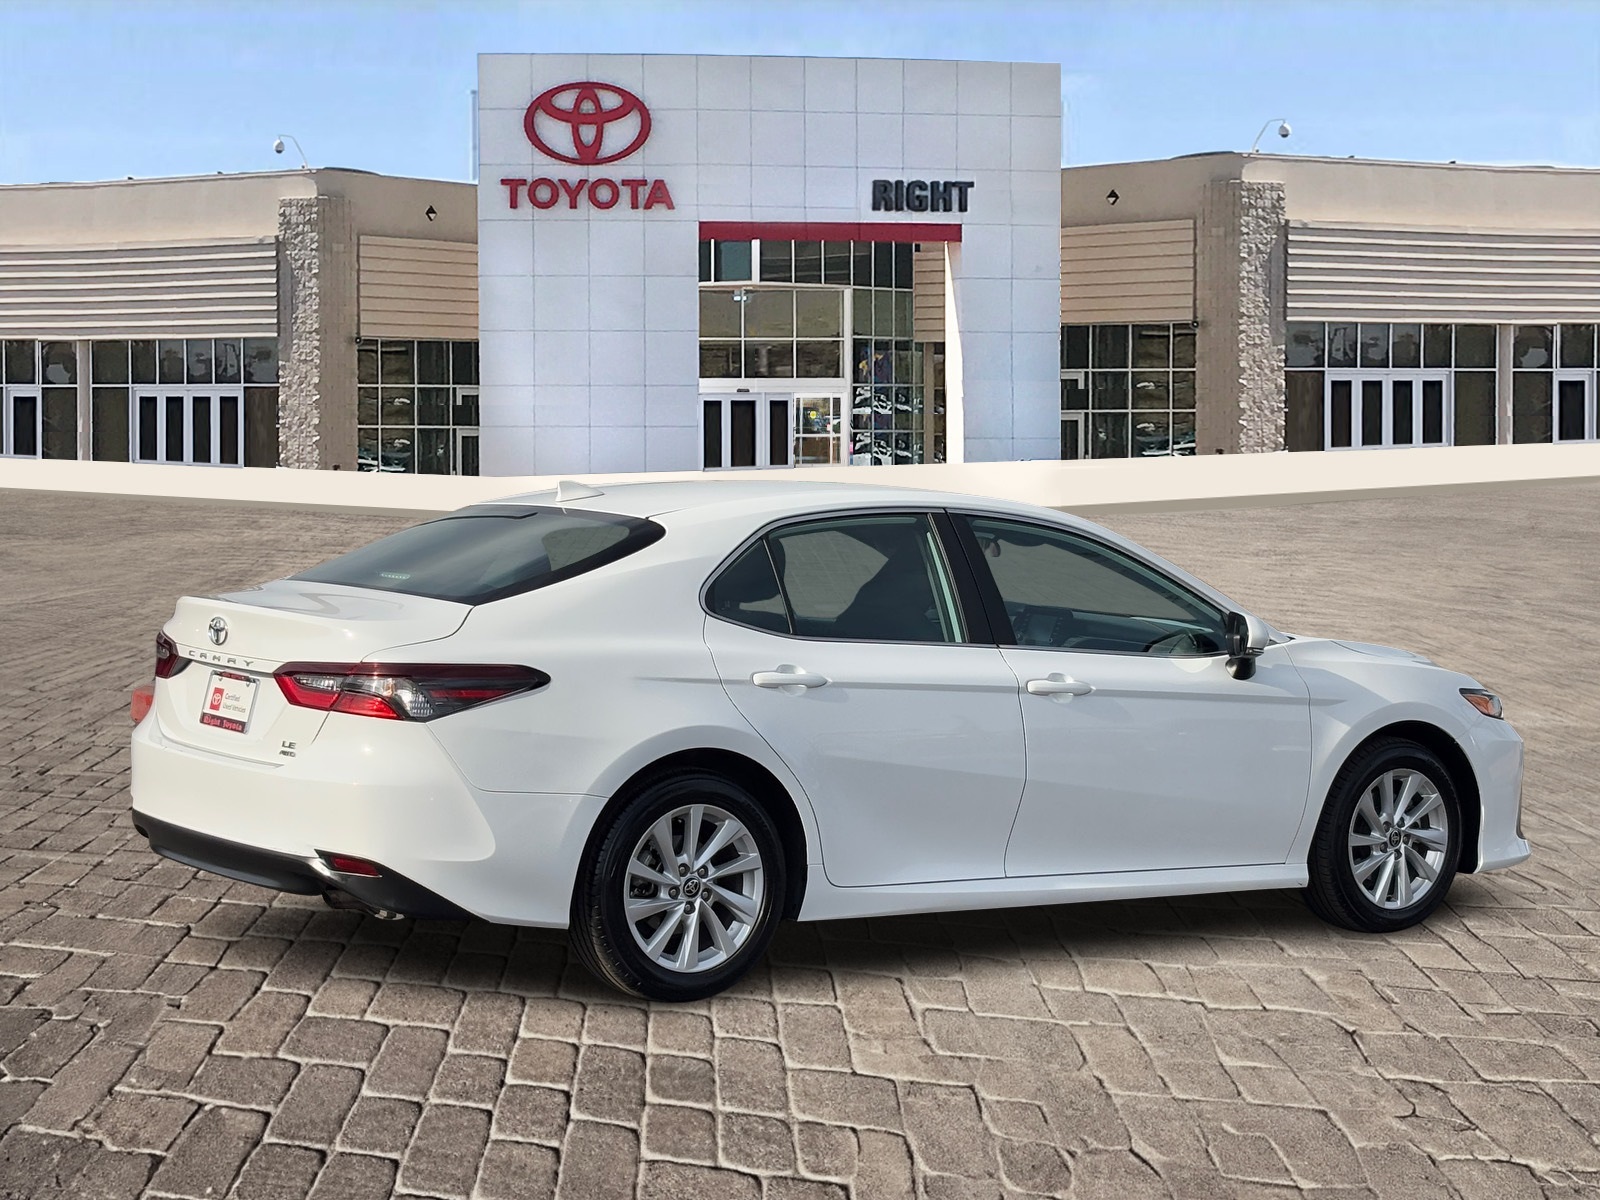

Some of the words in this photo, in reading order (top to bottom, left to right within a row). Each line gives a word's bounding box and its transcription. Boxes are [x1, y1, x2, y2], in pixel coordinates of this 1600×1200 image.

[500, 178, 675, 210] TOYOTA
[871, 179, 975, 213] RIGHT
[189, 650, 254, 666] CAMRY
[225, 693, 241, 702] Certified
[203, 715, 221, 727] Right
[222, 718, 243, 731] Toyota
[281, 740, 297, 750] LE
